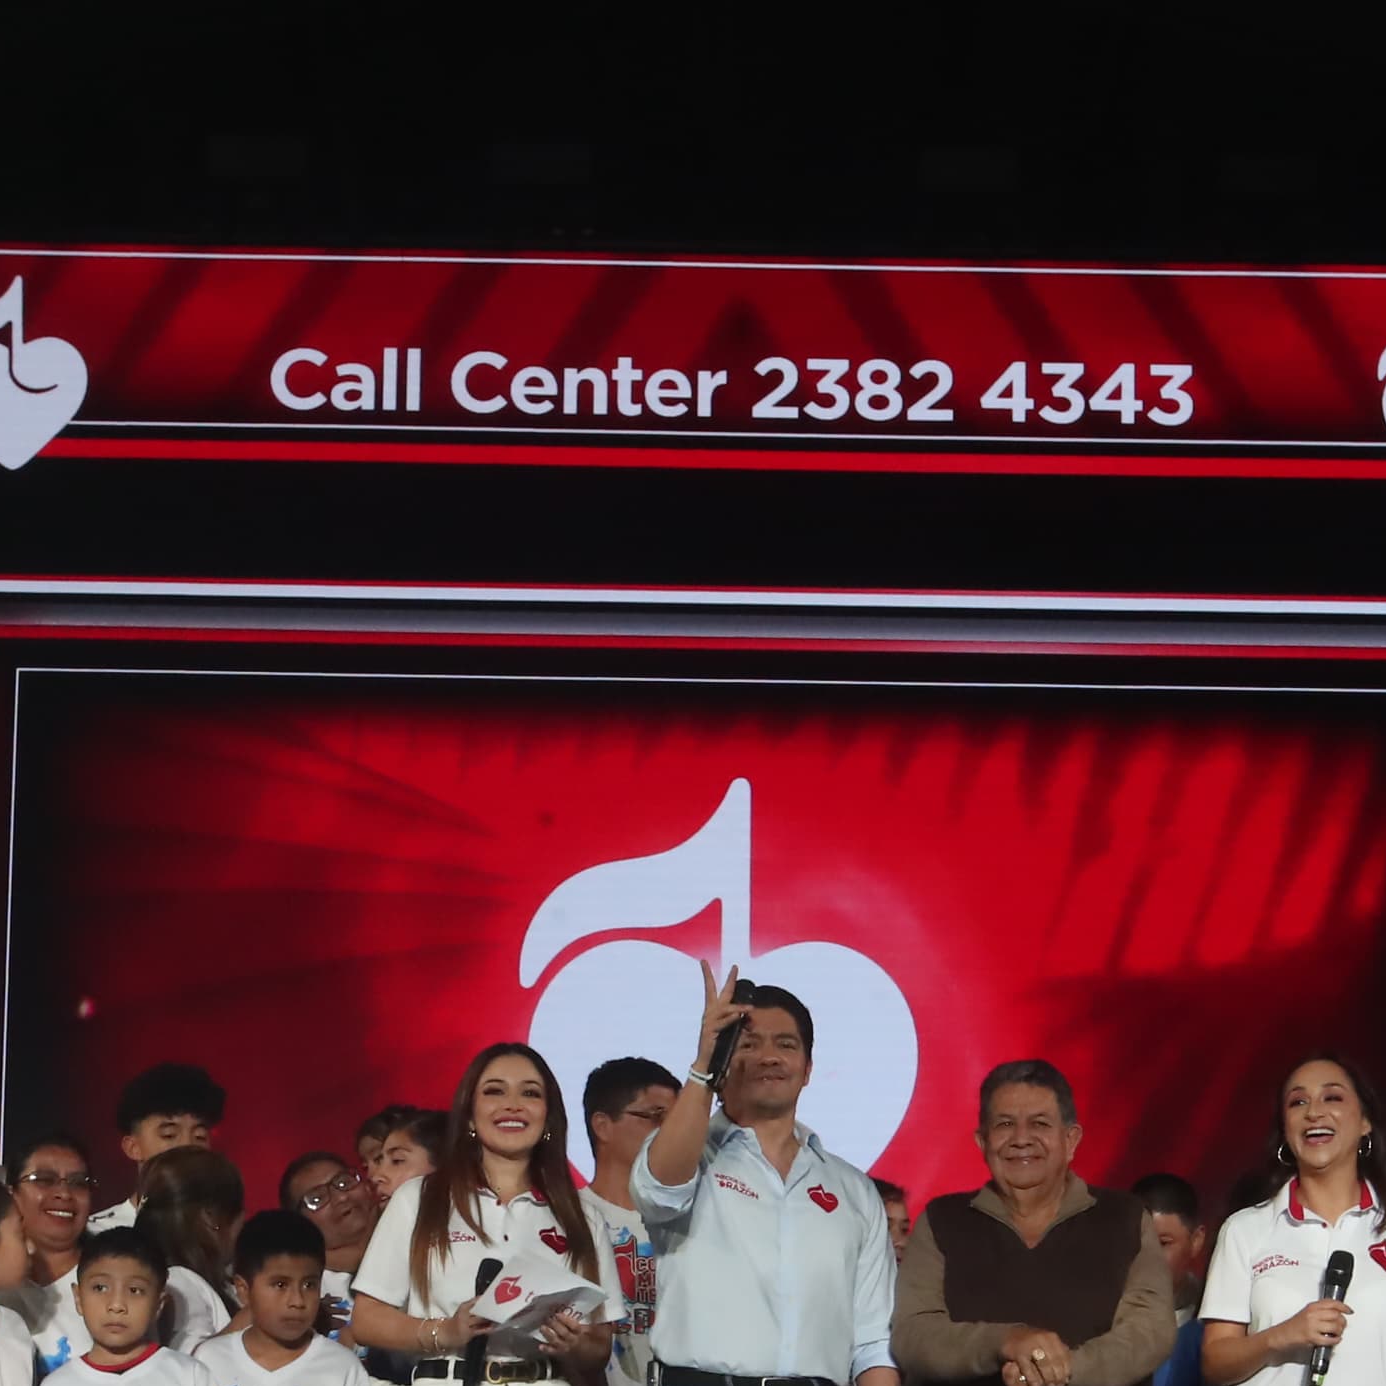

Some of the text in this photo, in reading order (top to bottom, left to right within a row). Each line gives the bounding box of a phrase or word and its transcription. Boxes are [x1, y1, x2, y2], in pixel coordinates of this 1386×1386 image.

[270, 347, 1194, 426] Call Center 2382 4343
